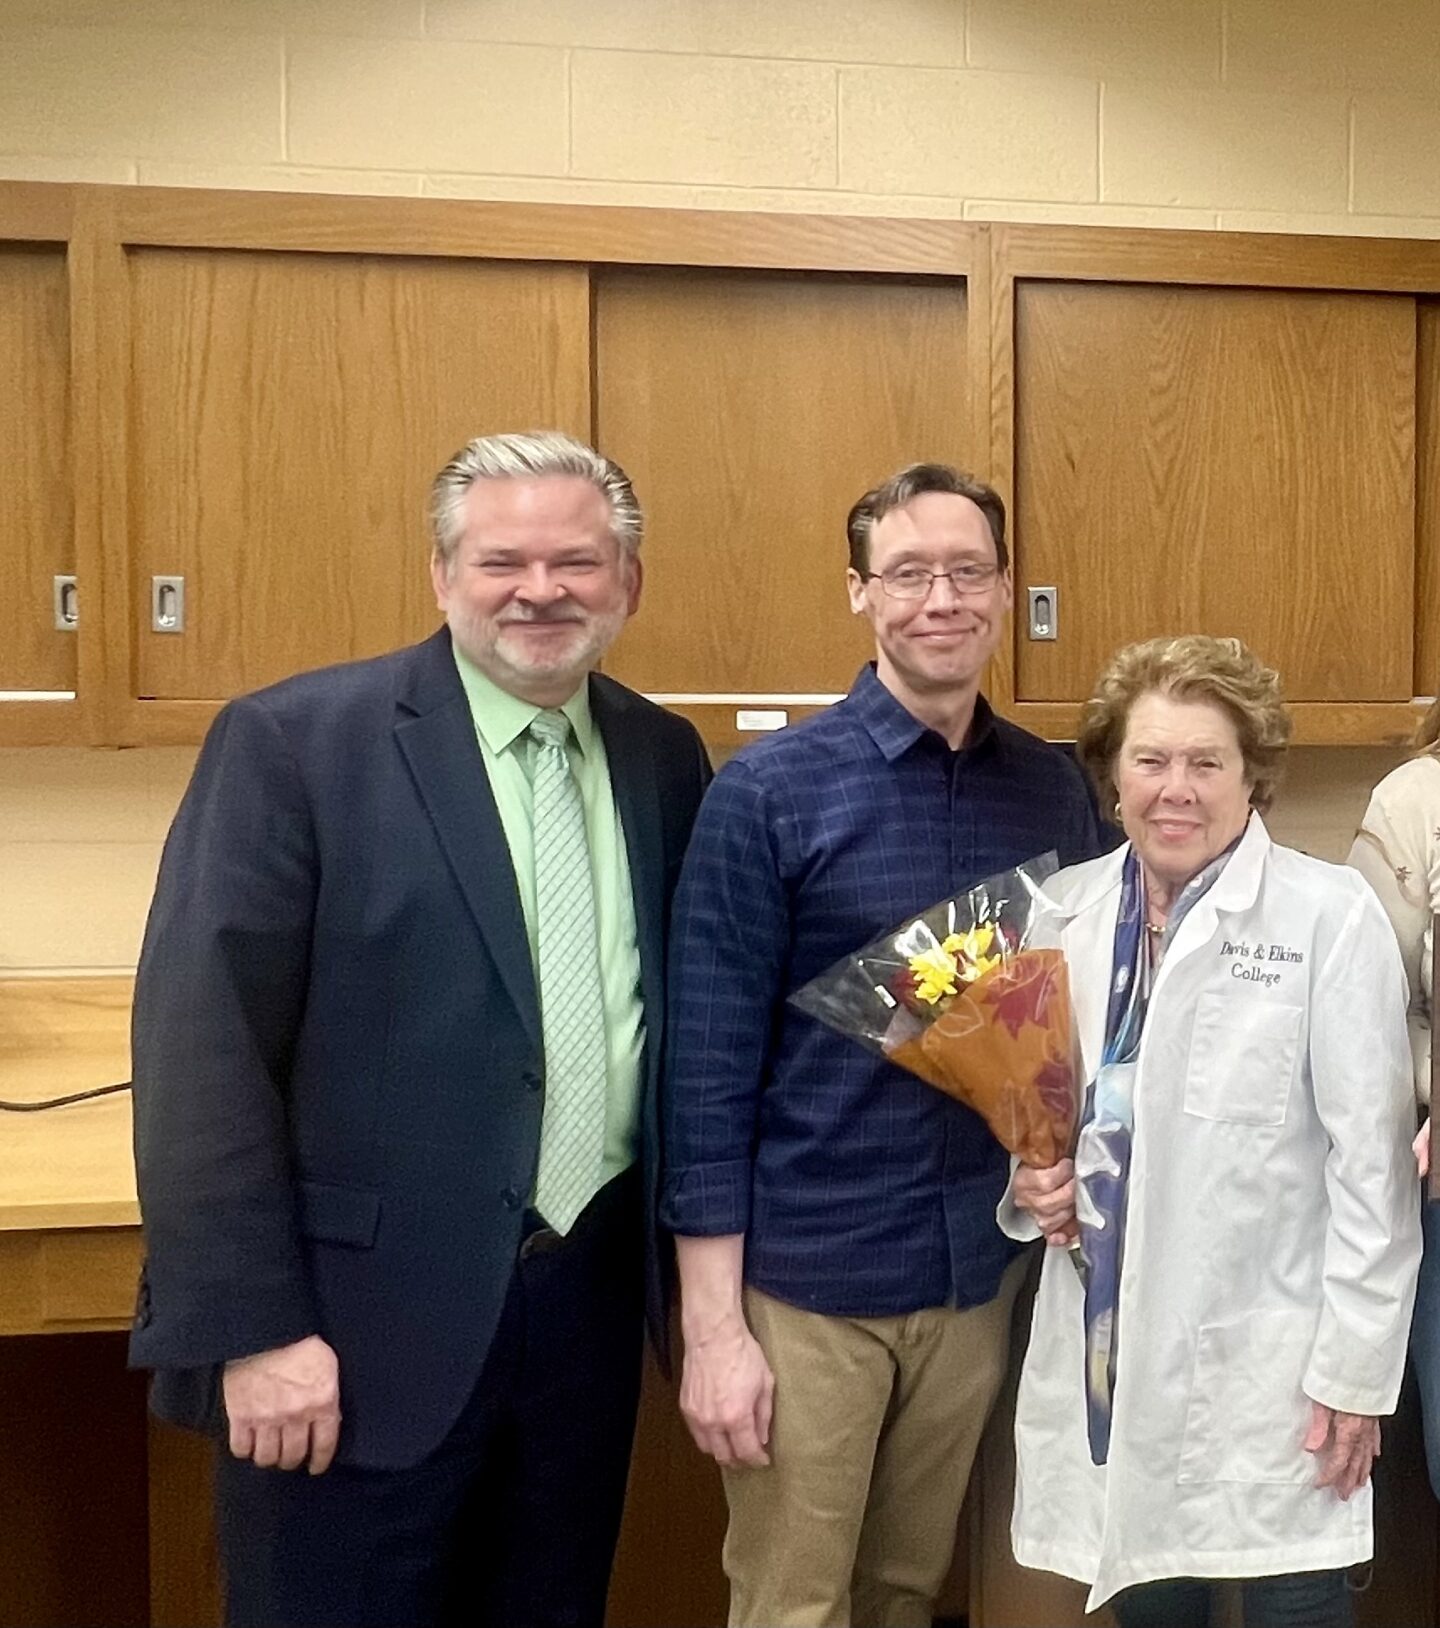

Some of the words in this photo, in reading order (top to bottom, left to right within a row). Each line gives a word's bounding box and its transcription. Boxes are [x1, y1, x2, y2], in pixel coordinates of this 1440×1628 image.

[1220, 941, 1250, 957] Davis
[1253, 944, 1265, 960] &
[1268, 945, 1304, 963] Elkins
[1231, 962, 1281, 988] College
